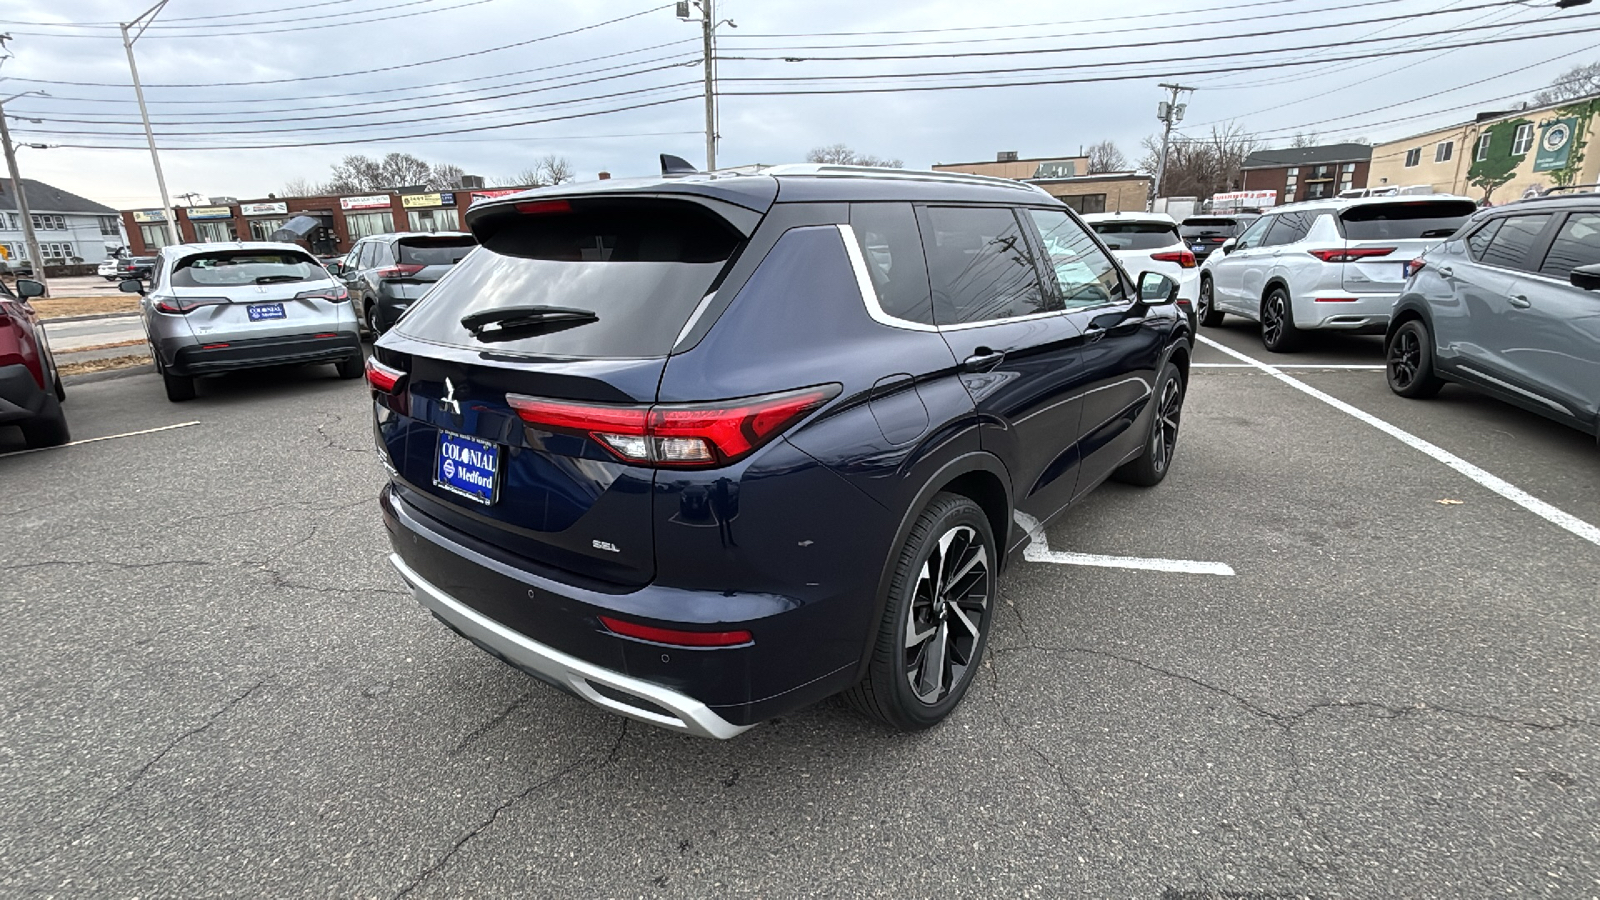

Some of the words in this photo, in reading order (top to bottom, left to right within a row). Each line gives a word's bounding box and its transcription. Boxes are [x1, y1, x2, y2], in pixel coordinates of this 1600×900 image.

[442, 442, 495, 472] COLONIAL
[458, 466, 492, 488] Medford
[592, 539, 620, 552] SEL
